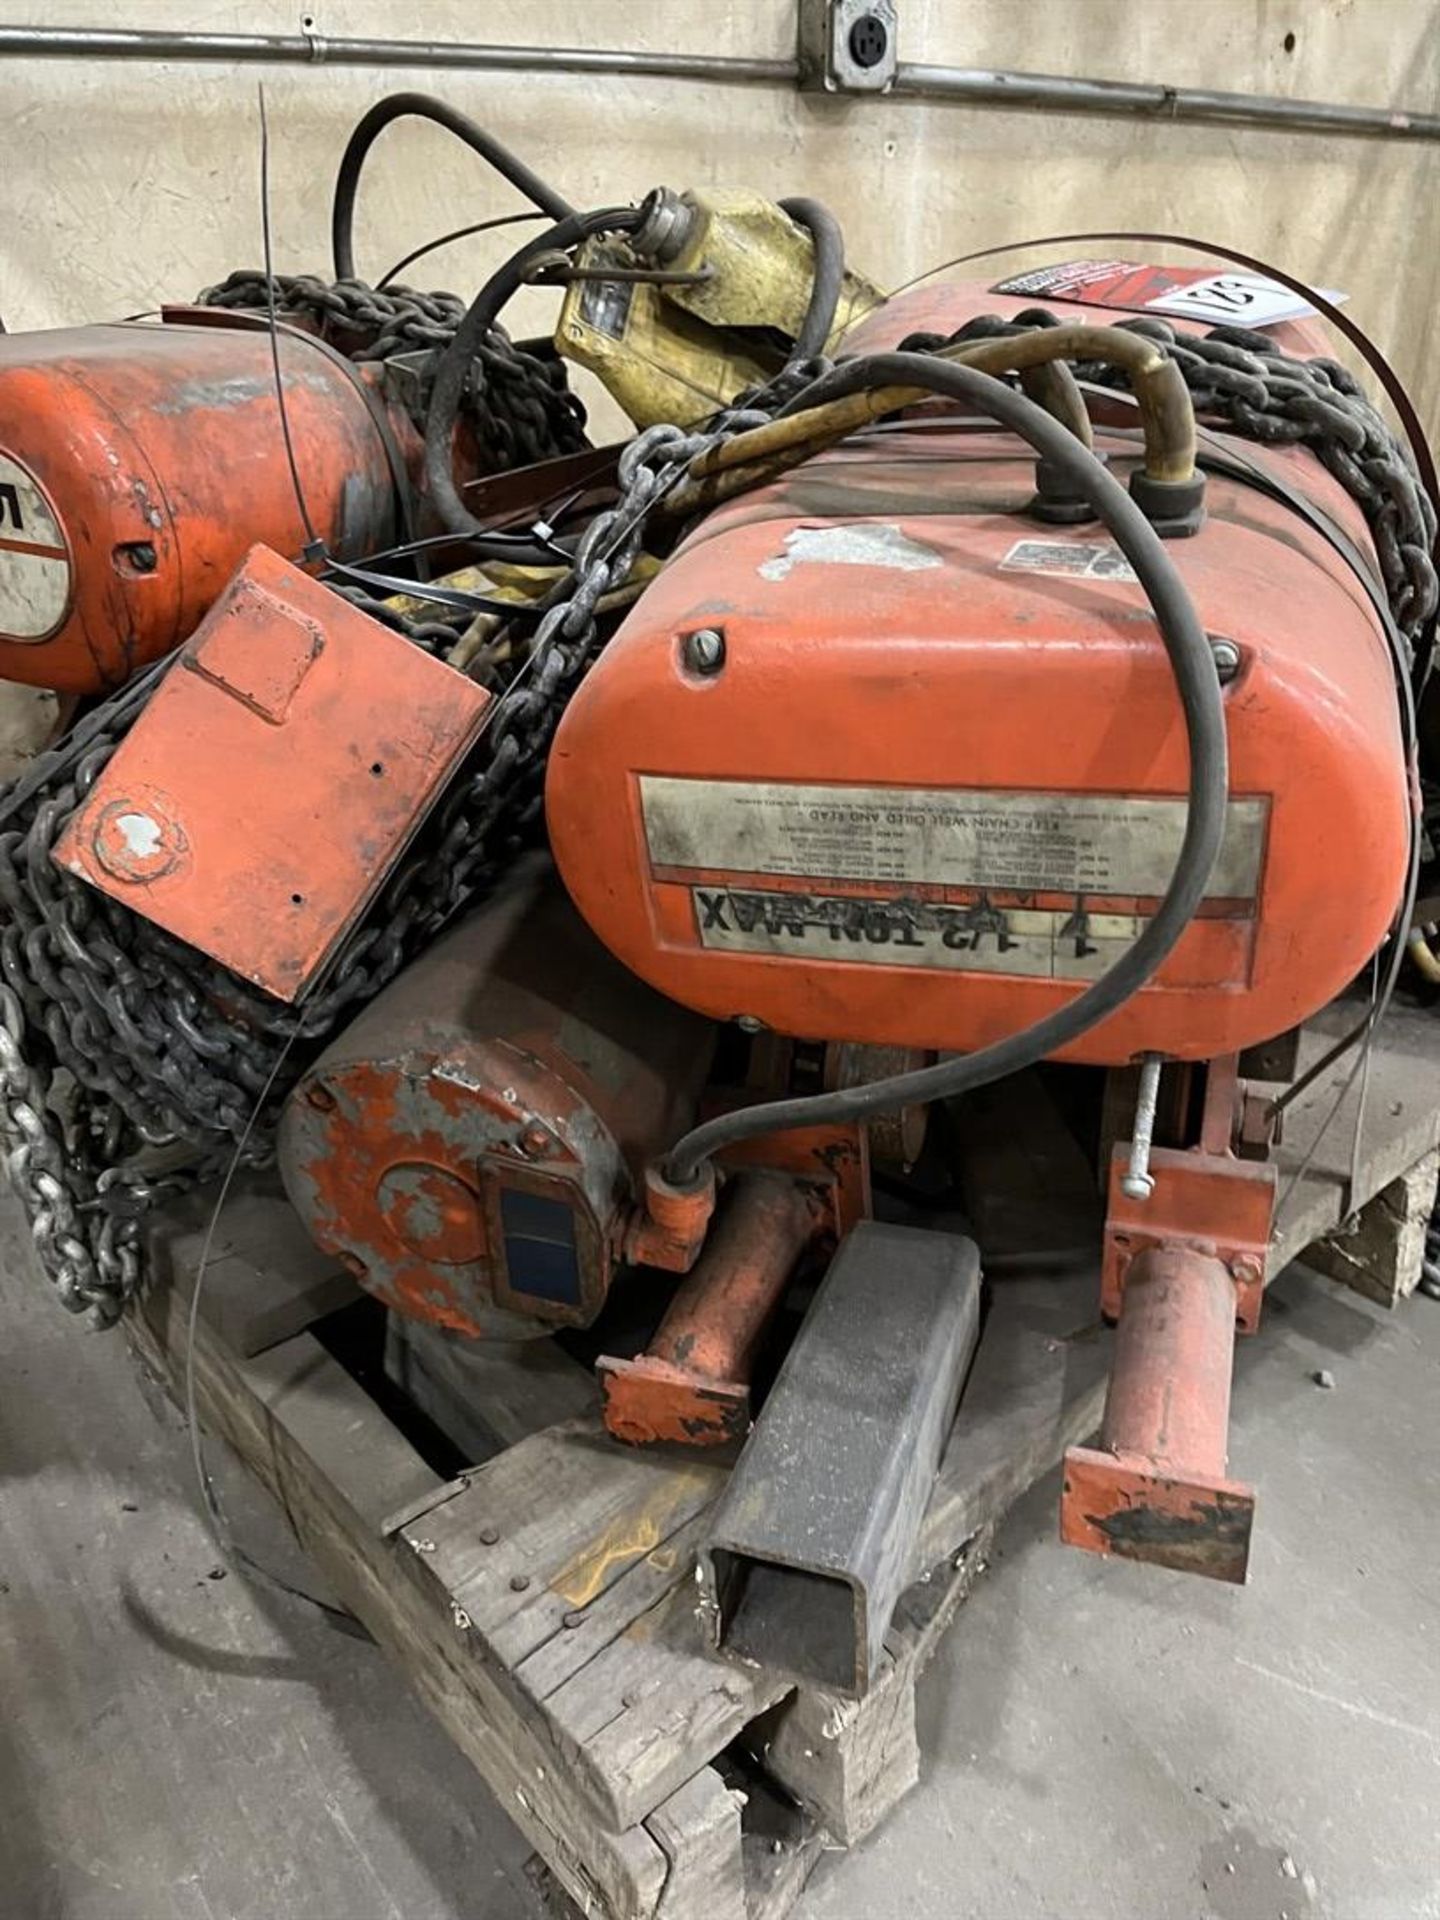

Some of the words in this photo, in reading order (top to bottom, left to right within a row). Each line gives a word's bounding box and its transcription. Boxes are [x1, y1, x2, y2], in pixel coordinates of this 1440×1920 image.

[809, 810, 844, 821] READ
[850, 812, 879, 823] AND
[886, 813, 926, 826] OILED
[931, 814, 967, 828] WELL
[973, 817, 1020, 830] CHAIN
